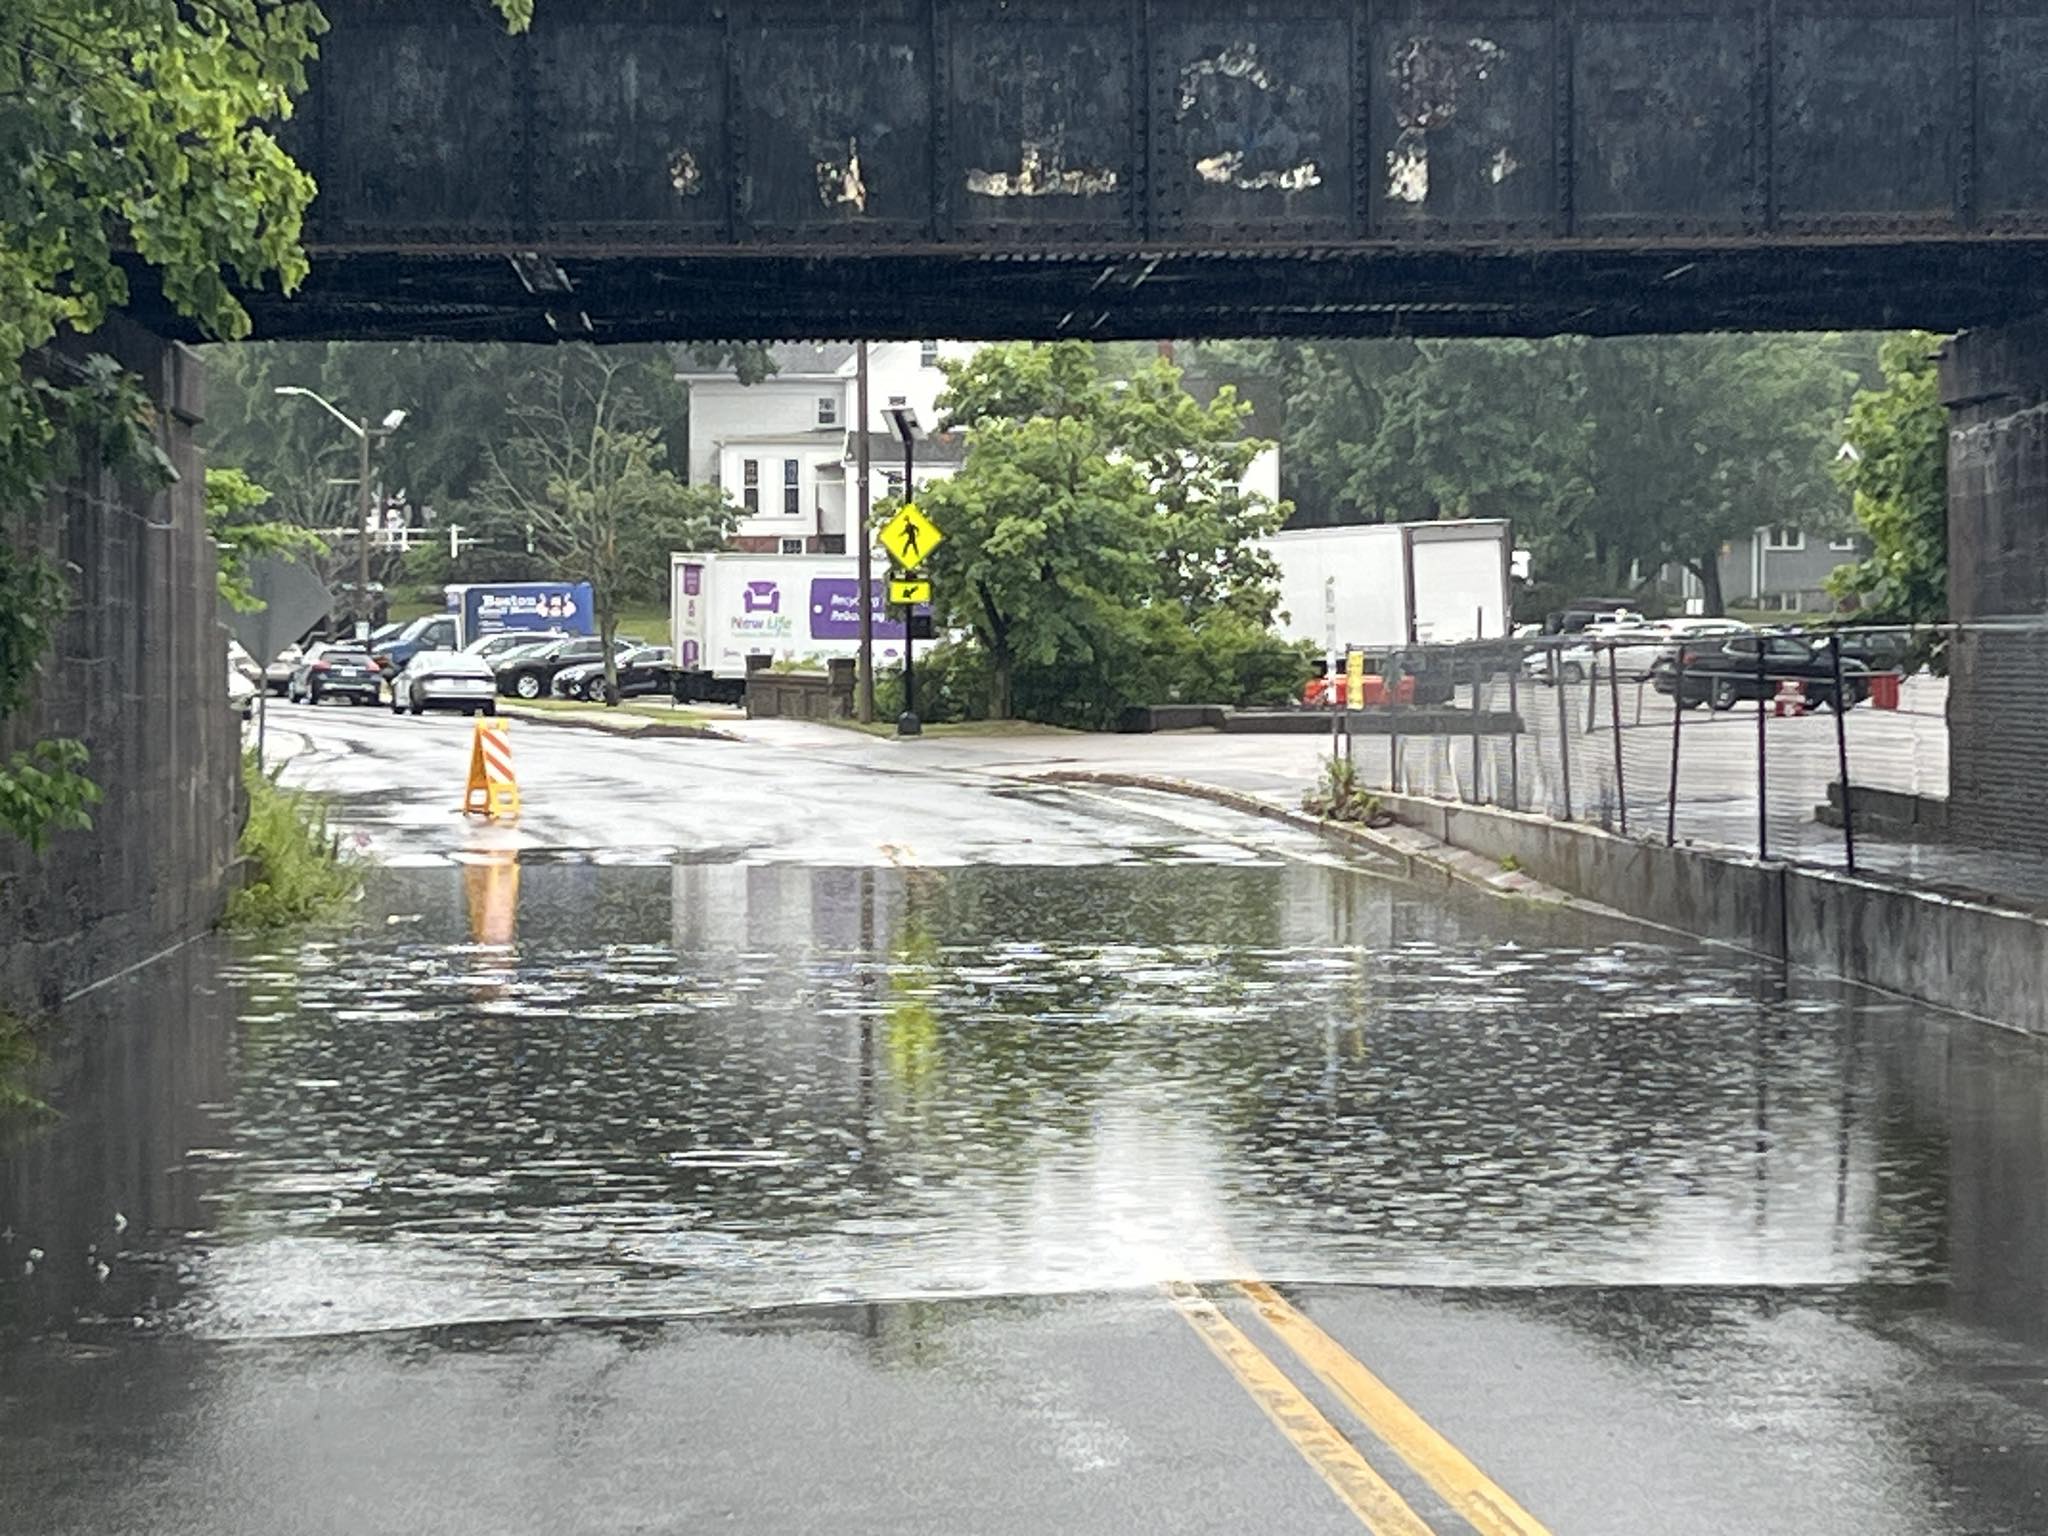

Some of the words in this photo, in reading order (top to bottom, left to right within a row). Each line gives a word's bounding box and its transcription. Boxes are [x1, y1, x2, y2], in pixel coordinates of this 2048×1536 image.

[482, 595, 536, 607] Boston
[731, 616, 764, 629] New
[767, 616, 792, 633] Life
